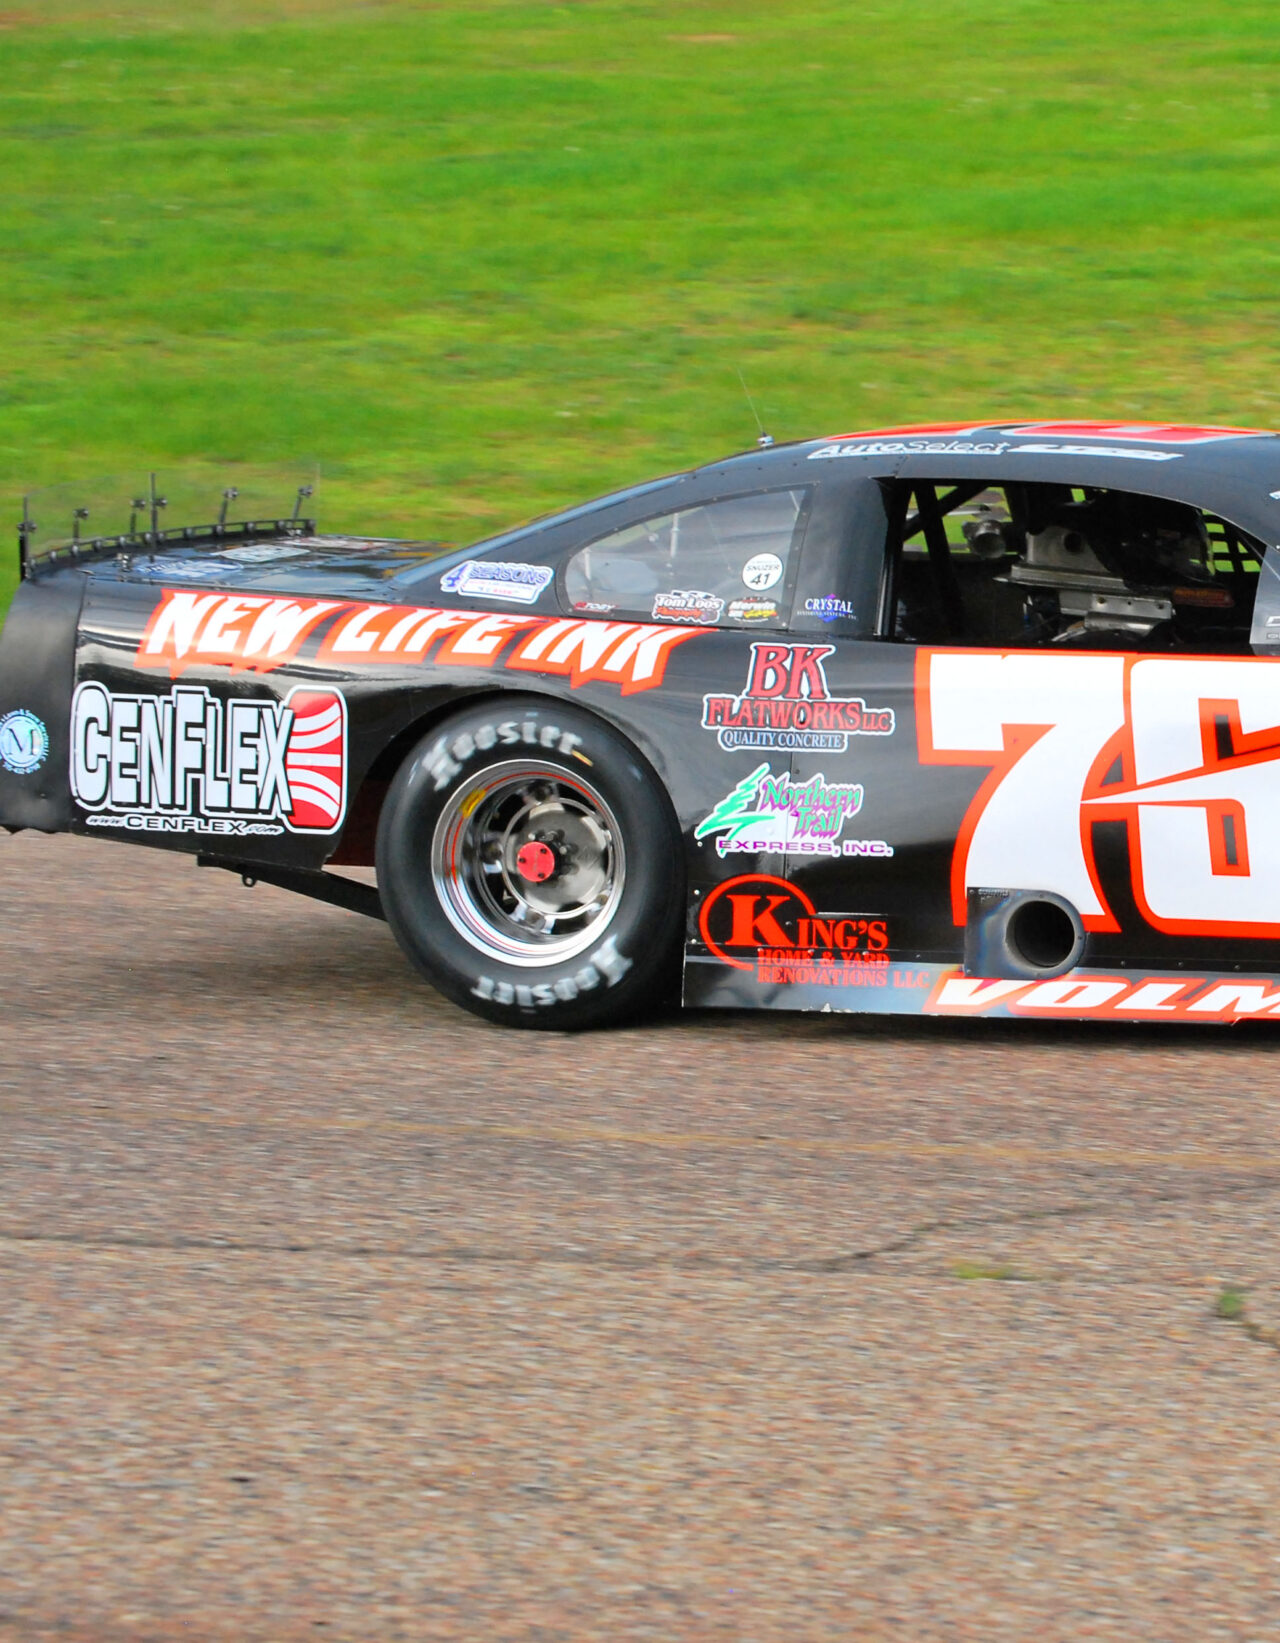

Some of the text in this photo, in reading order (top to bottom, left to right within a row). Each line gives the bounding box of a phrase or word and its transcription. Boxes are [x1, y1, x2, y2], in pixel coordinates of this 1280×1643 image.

[441, 562, 469, 588] 4
[469, 566, 549, 586] SEASONS
[750, 573, 771, 585] 41
[804, 598, 854, 614] CRYSTAL
[142, 590, 700, 688] NEW LIFE INK
[748, 644, 832, 700] BK
[706, 697, 890, 732] FLATWORKS LLC
[72, 684, 297, 813] CENFLEX
[723, 730, 843, 748] QUALITY CONCRETE
[760, 774, 862, 814] Northern
[795, 804, 843, 838] Trail
[718, 840, 893, 855] EXPRESS, INC.
[724, 893, 890, 952] KING'S
[757, 949, 891, 970] HOME & YARD
[757, 966, 931, 989] RENOVATIONS LLC
